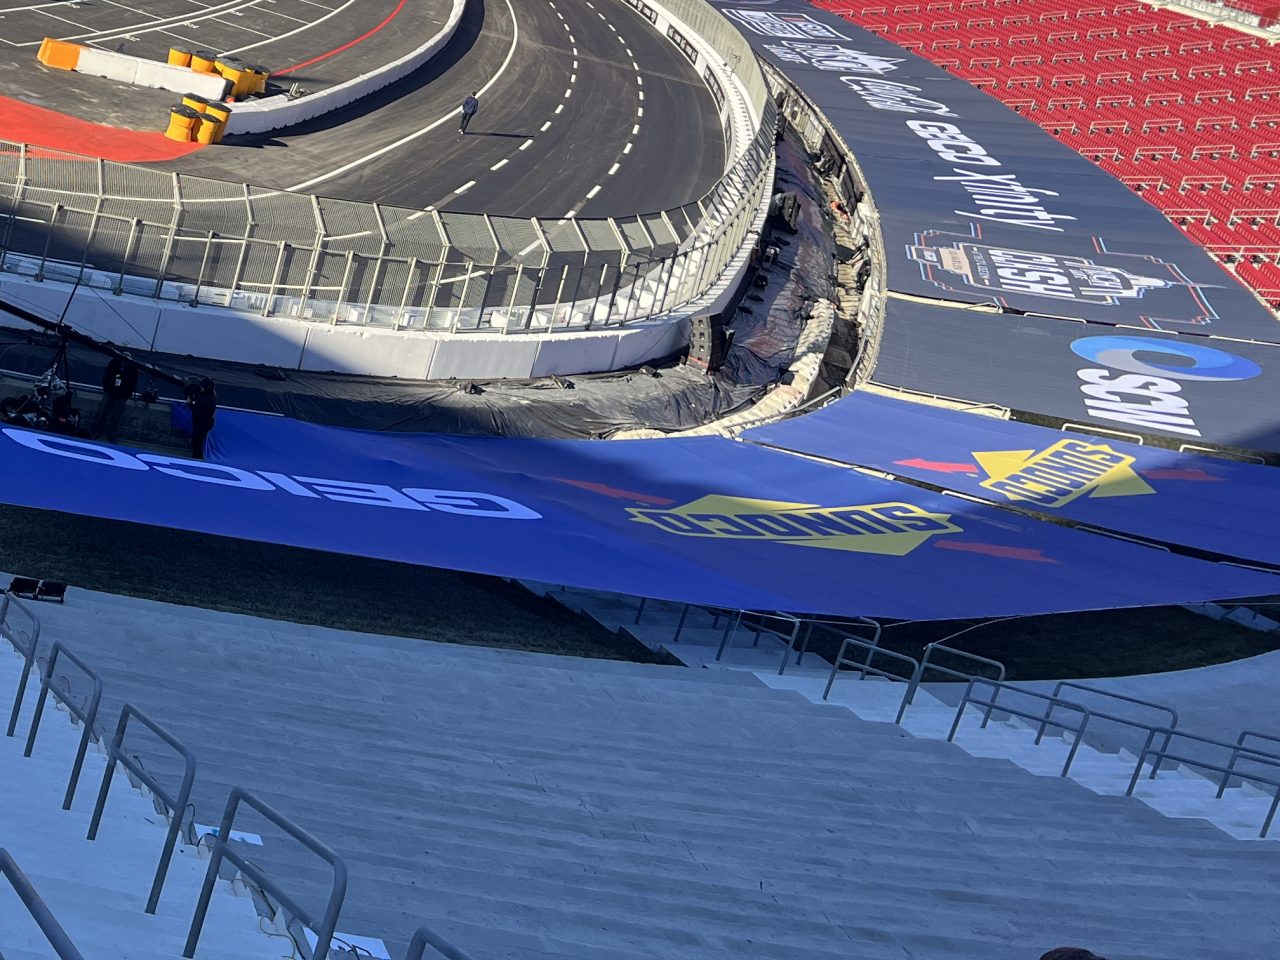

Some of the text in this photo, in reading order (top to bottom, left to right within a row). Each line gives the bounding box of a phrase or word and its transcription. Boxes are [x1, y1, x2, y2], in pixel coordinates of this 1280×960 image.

[905, 120, 1002, 166] GEICO
[988, 249, 1076, 298] CLASH
[1, 427, 543, 520] GEICO
[988, 440, 1128, 506] SUNOCO
[636, 504, 952, 537] SUNOCO
